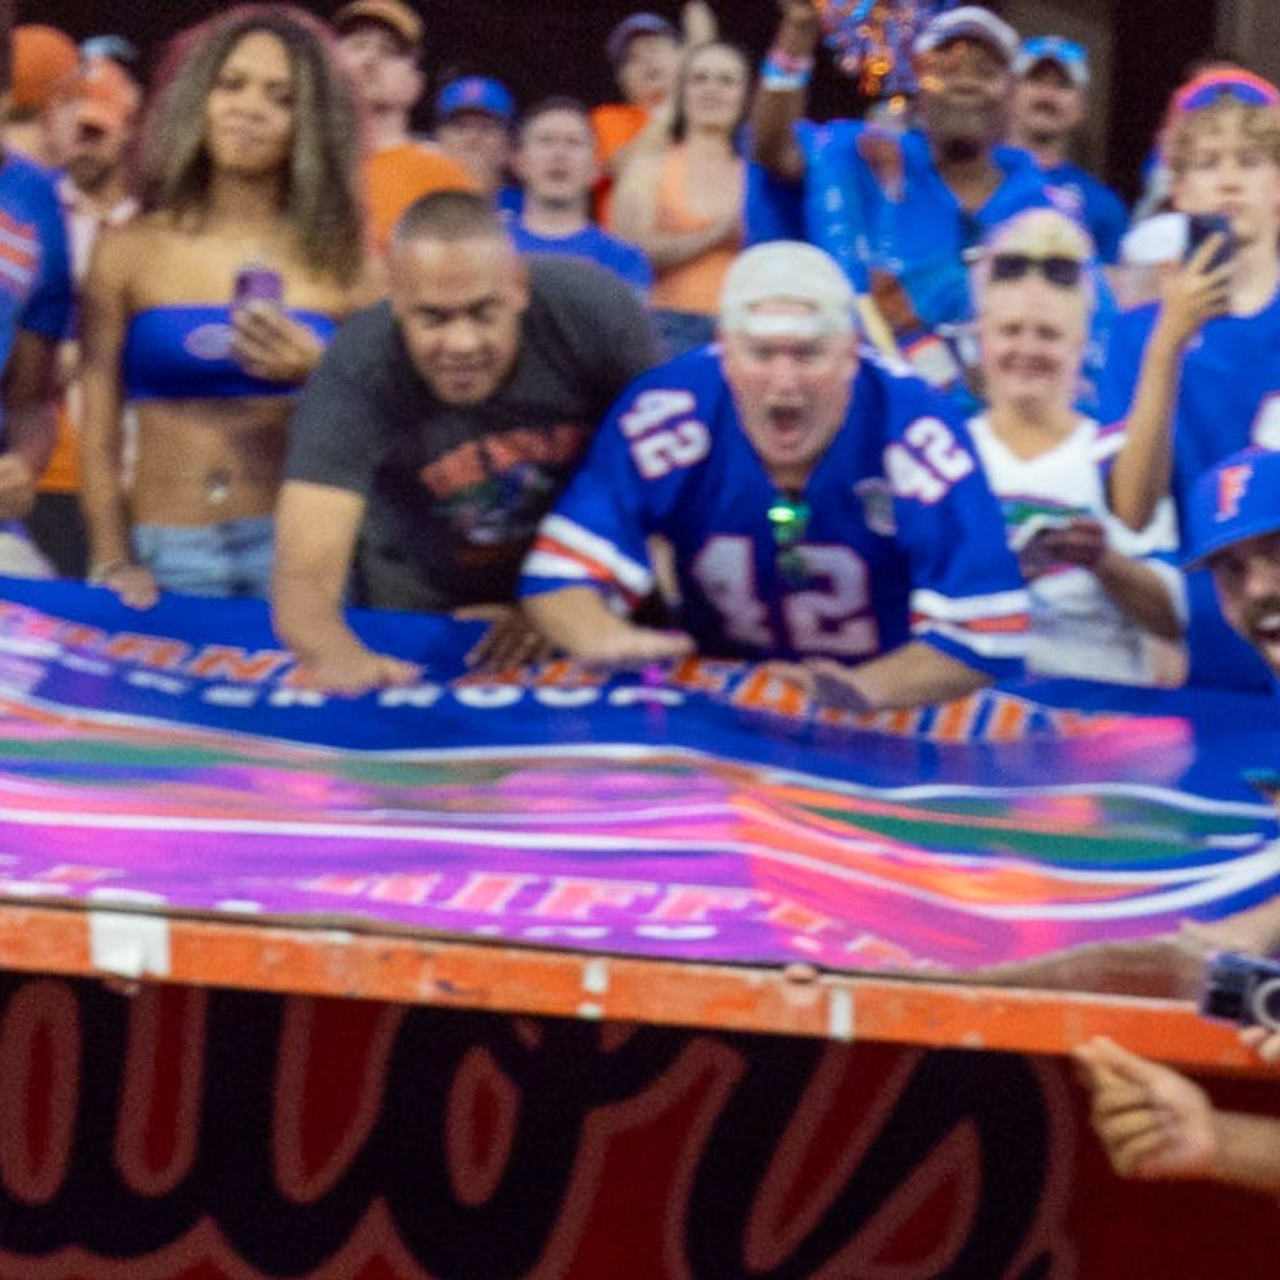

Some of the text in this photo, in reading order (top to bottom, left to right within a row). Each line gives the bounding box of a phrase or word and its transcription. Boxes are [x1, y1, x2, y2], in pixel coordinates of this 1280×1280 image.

[619, 388, 712, 480] 42
[884, 416, 976, 504] 42
[1215, 463, 1254, 523] F
